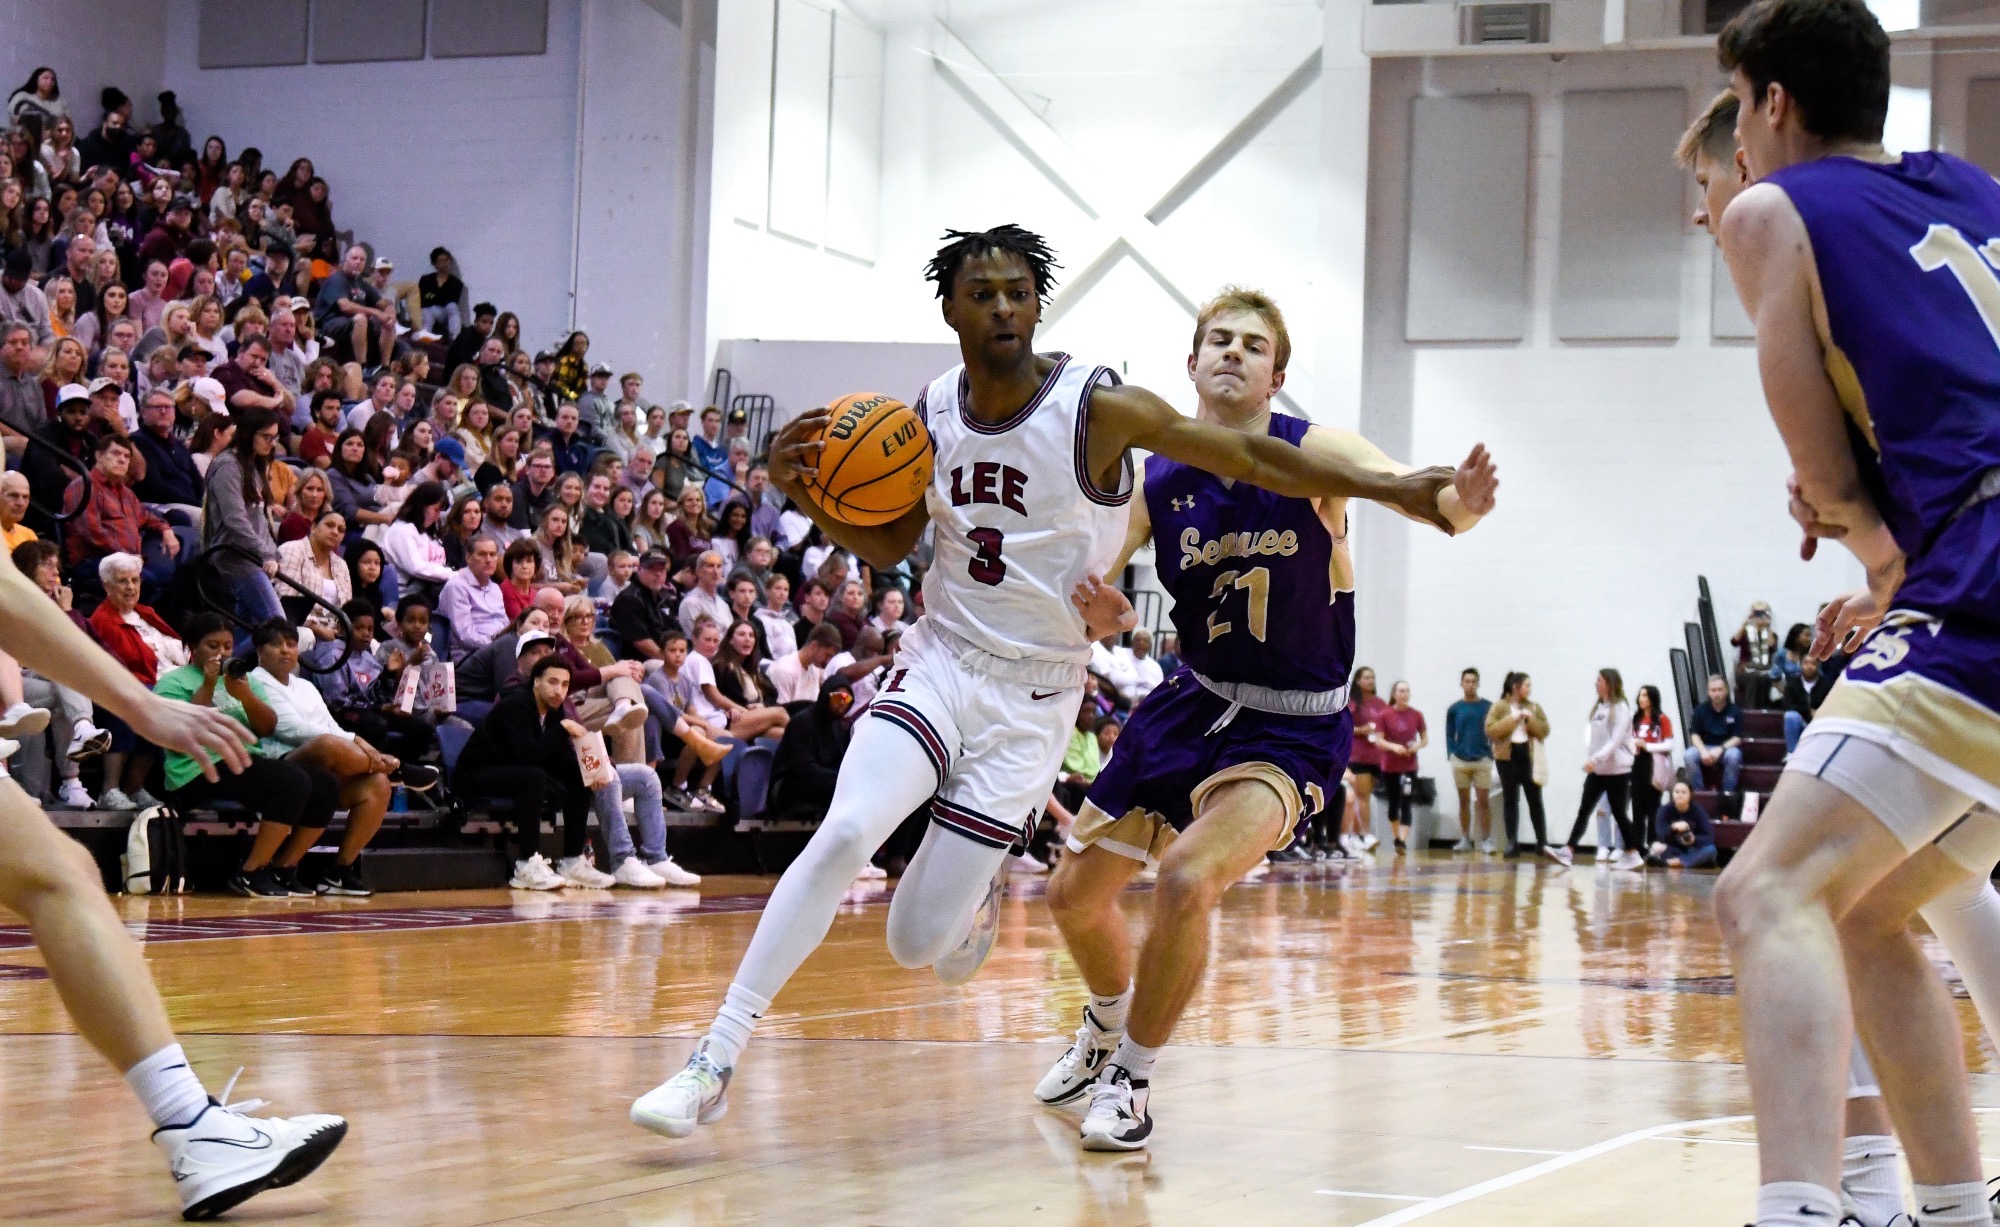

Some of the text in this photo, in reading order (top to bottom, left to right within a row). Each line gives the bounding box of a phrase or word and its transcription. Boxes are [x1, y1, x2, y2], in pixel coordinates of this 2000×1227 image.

[829, 394, 898, 440] Wilso
[951, 462, 1029, 517] LEE
[966, 526, 1007, 587] 3
[1207, 566, 1270, 643] 21
